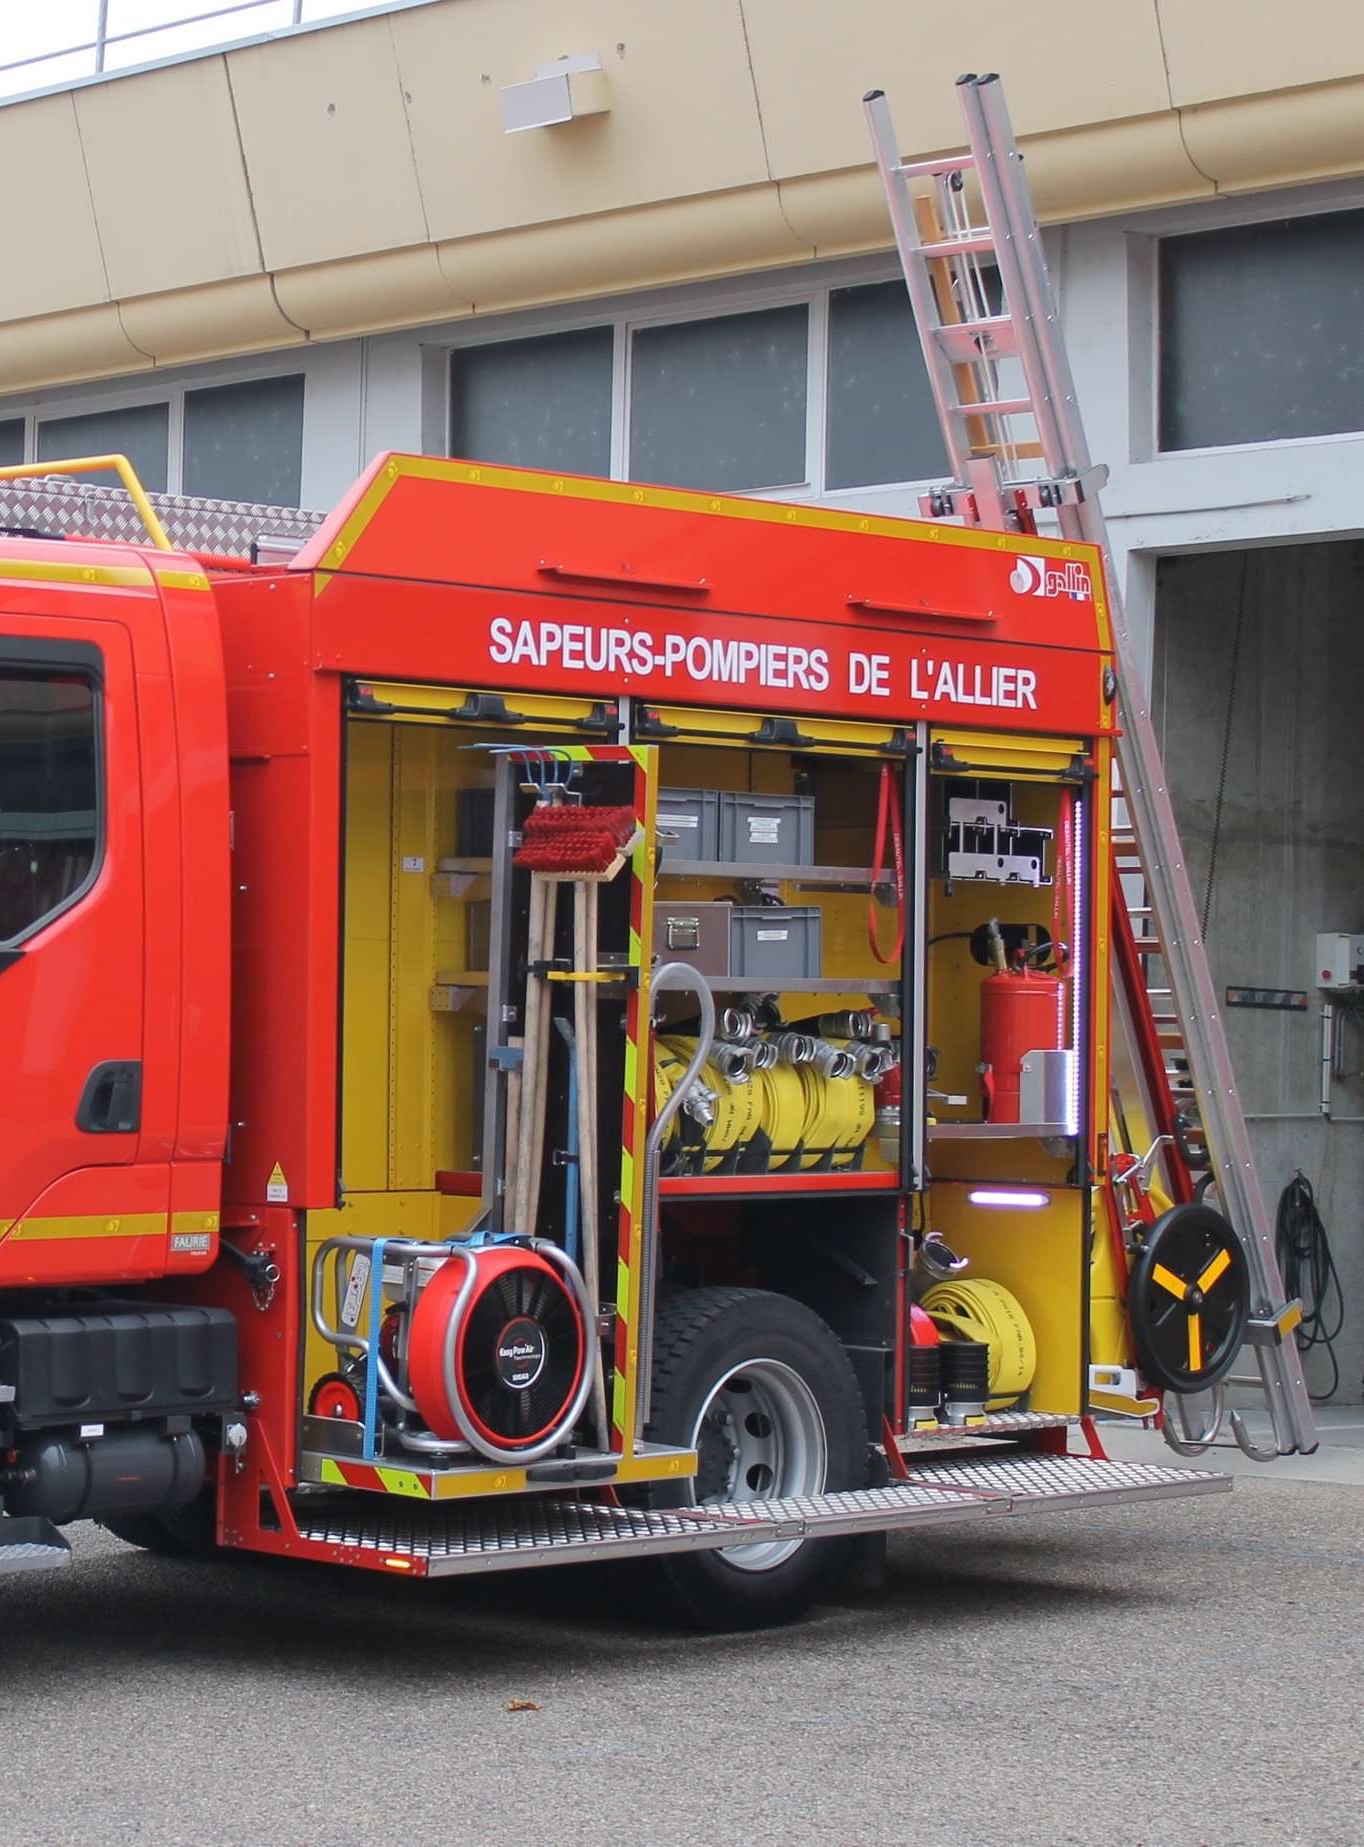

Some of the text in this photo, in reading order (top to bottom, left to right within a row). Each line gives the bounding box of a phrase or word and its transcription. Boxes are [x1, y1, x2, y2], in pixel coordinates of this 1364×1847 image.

[489, 617, 1038, 710] SAPEURS-POMPIERS DE L'ALLIER
[893, 832, 901, 870] DESAUTEL
[174, 1235, 208, 1248] FAURIE
[499, 1347, 513, 1358] Easy
